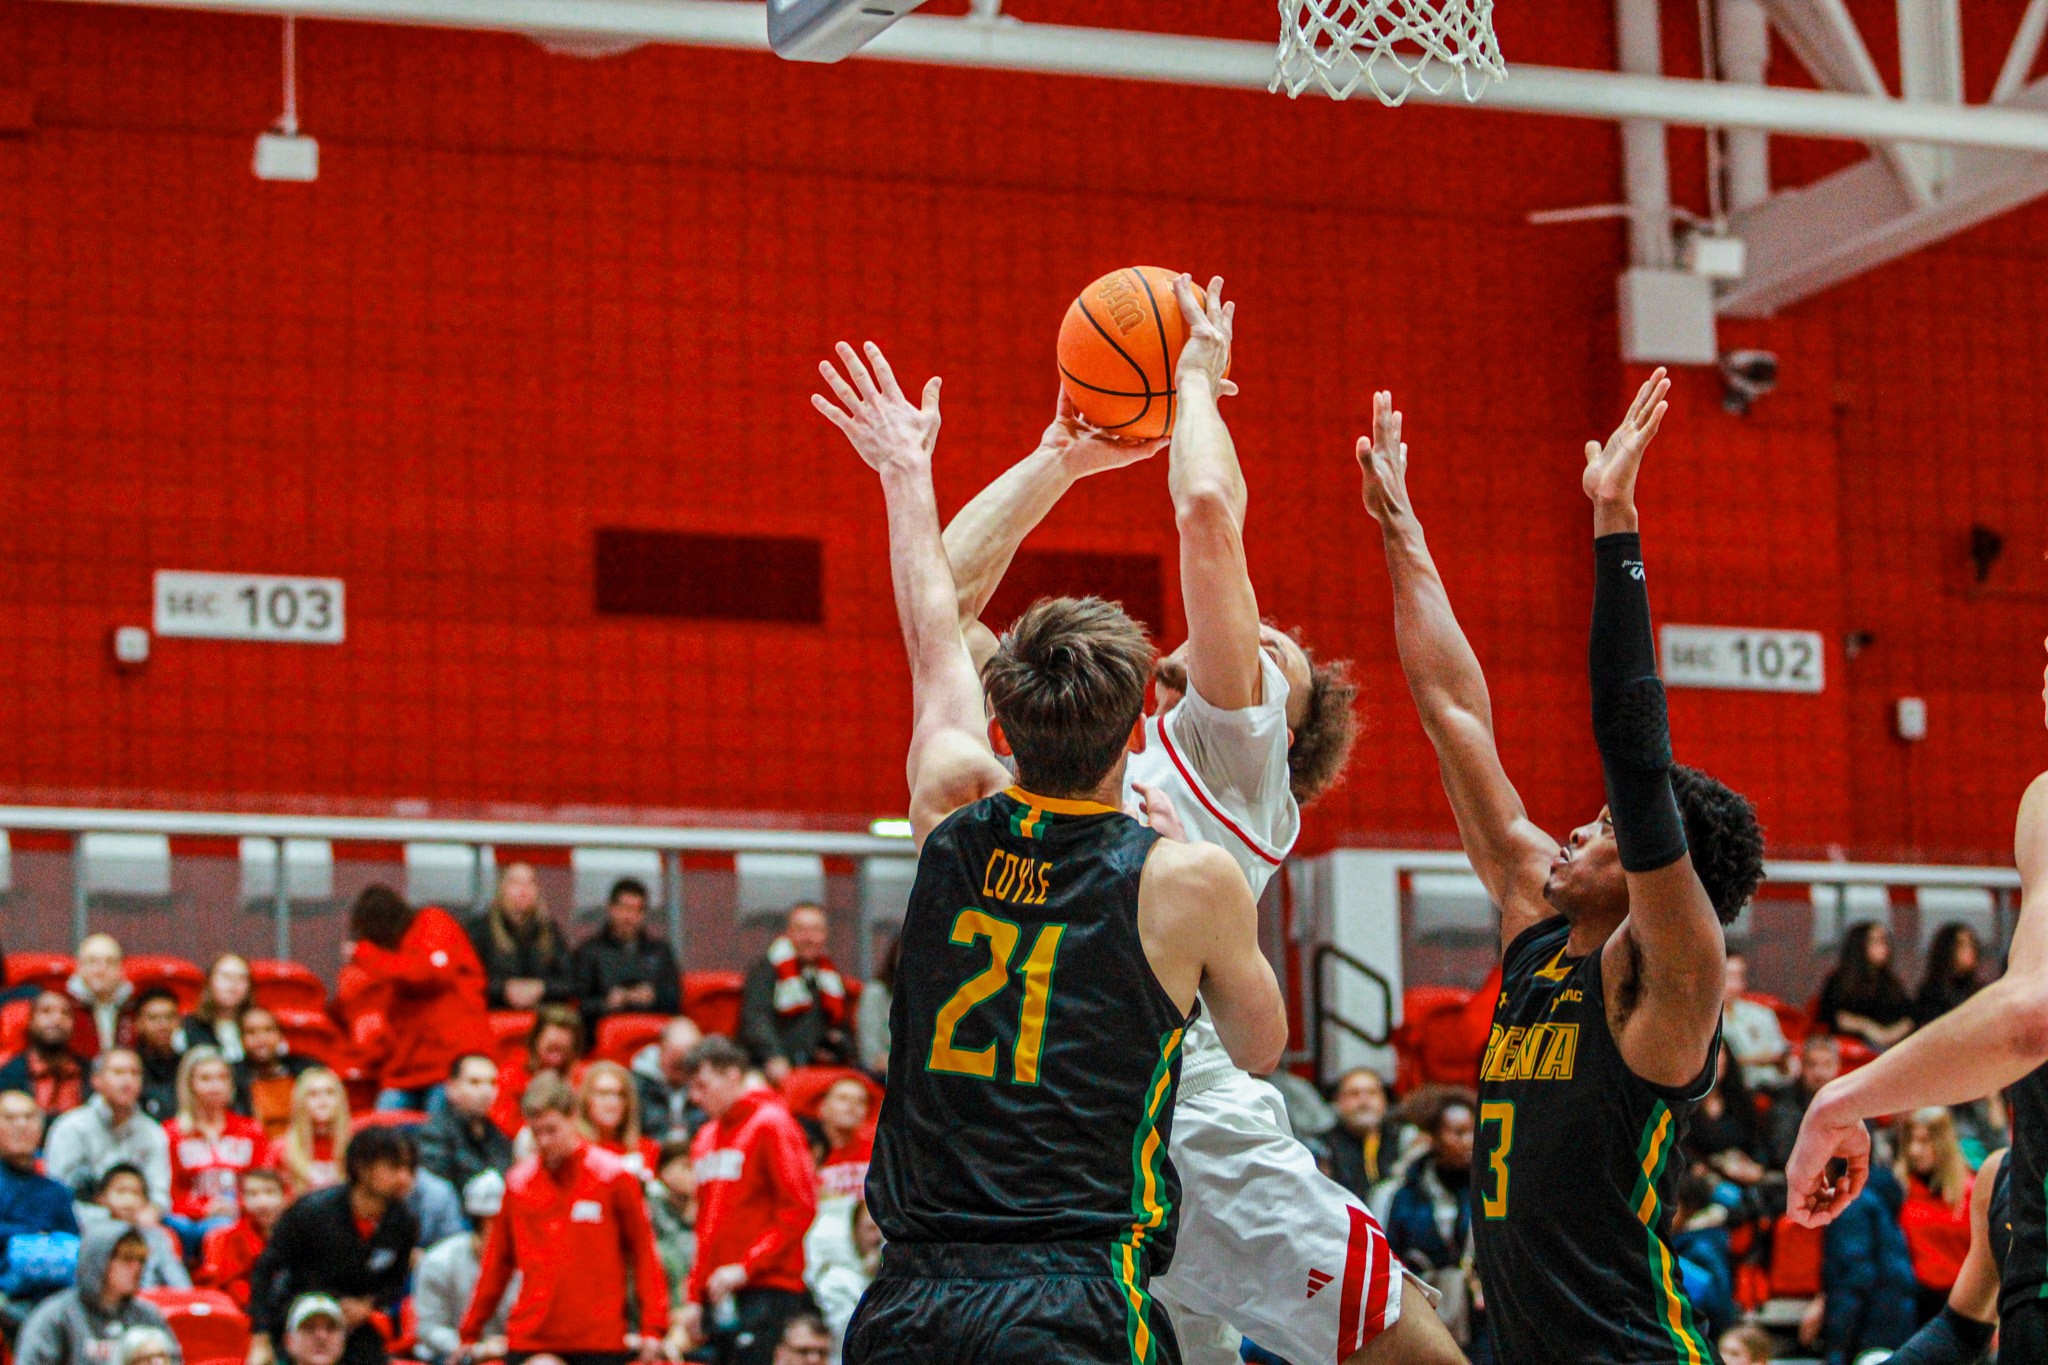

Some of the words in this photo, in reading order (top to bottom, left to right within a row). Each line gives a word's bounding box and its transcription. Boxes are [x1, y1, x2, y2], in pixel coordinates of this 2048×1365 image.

[238, 585, 333, 631] 103
[1733, 636, 1814, 682] 102
[982, 848, 1053, 905] COYLE
[925, 906, 1068, 1086] 21
[1480, 1100, 1516, 1221] 3
